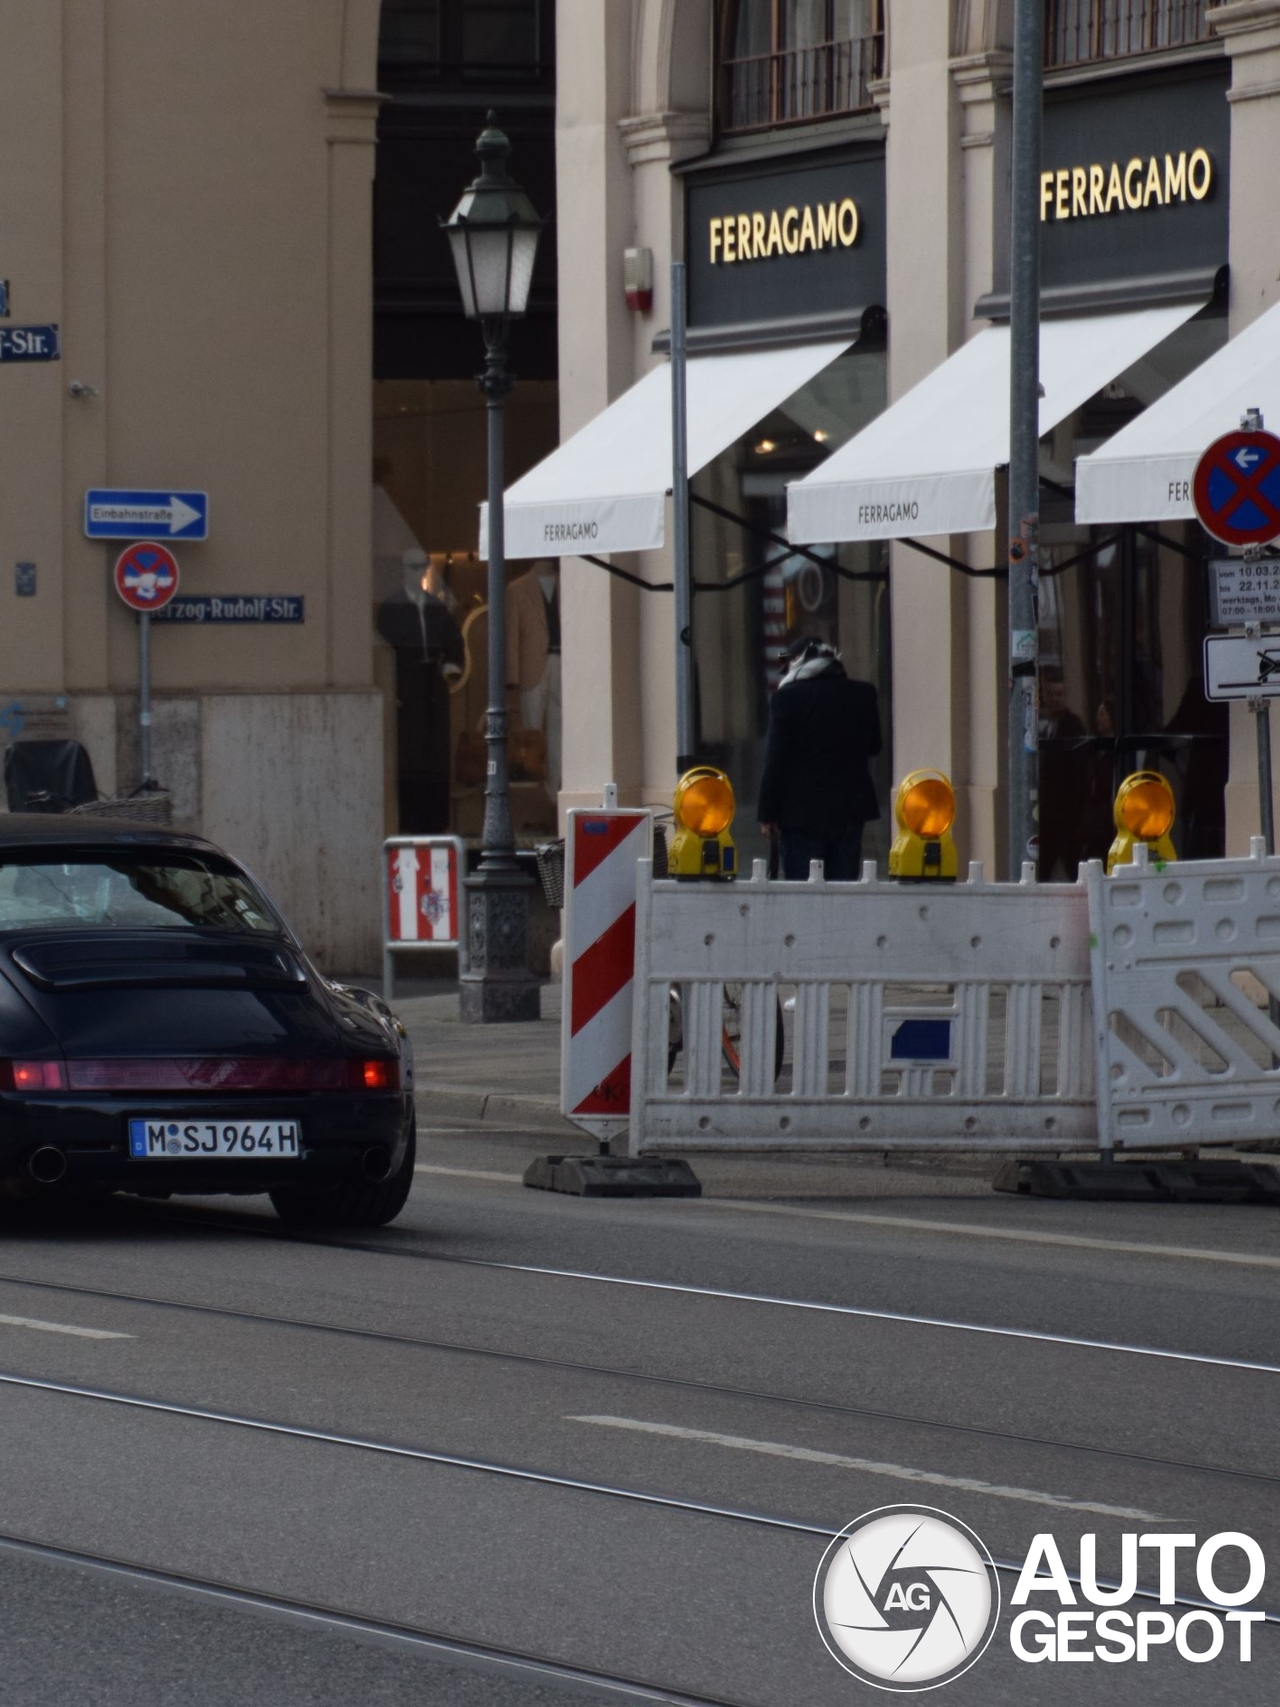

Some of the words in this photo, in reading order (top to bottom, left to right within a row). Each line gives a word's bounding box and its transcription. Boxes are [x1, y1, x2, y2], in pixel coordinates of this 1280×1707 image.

[1040, 147, 1212, 222] FERRAGAMO
[709, 198, 859, 264] FERRAGAMO
[93, 508, 173, 520] Einbahnstraße
[858, 502, 919, 524] FERRAGAMO
[544, 522, 598, 542] FERRAGAMO
[152, 598, 300, 622] erzog-Rudolf-Str.
[148, 1125, 166, 1152] M
